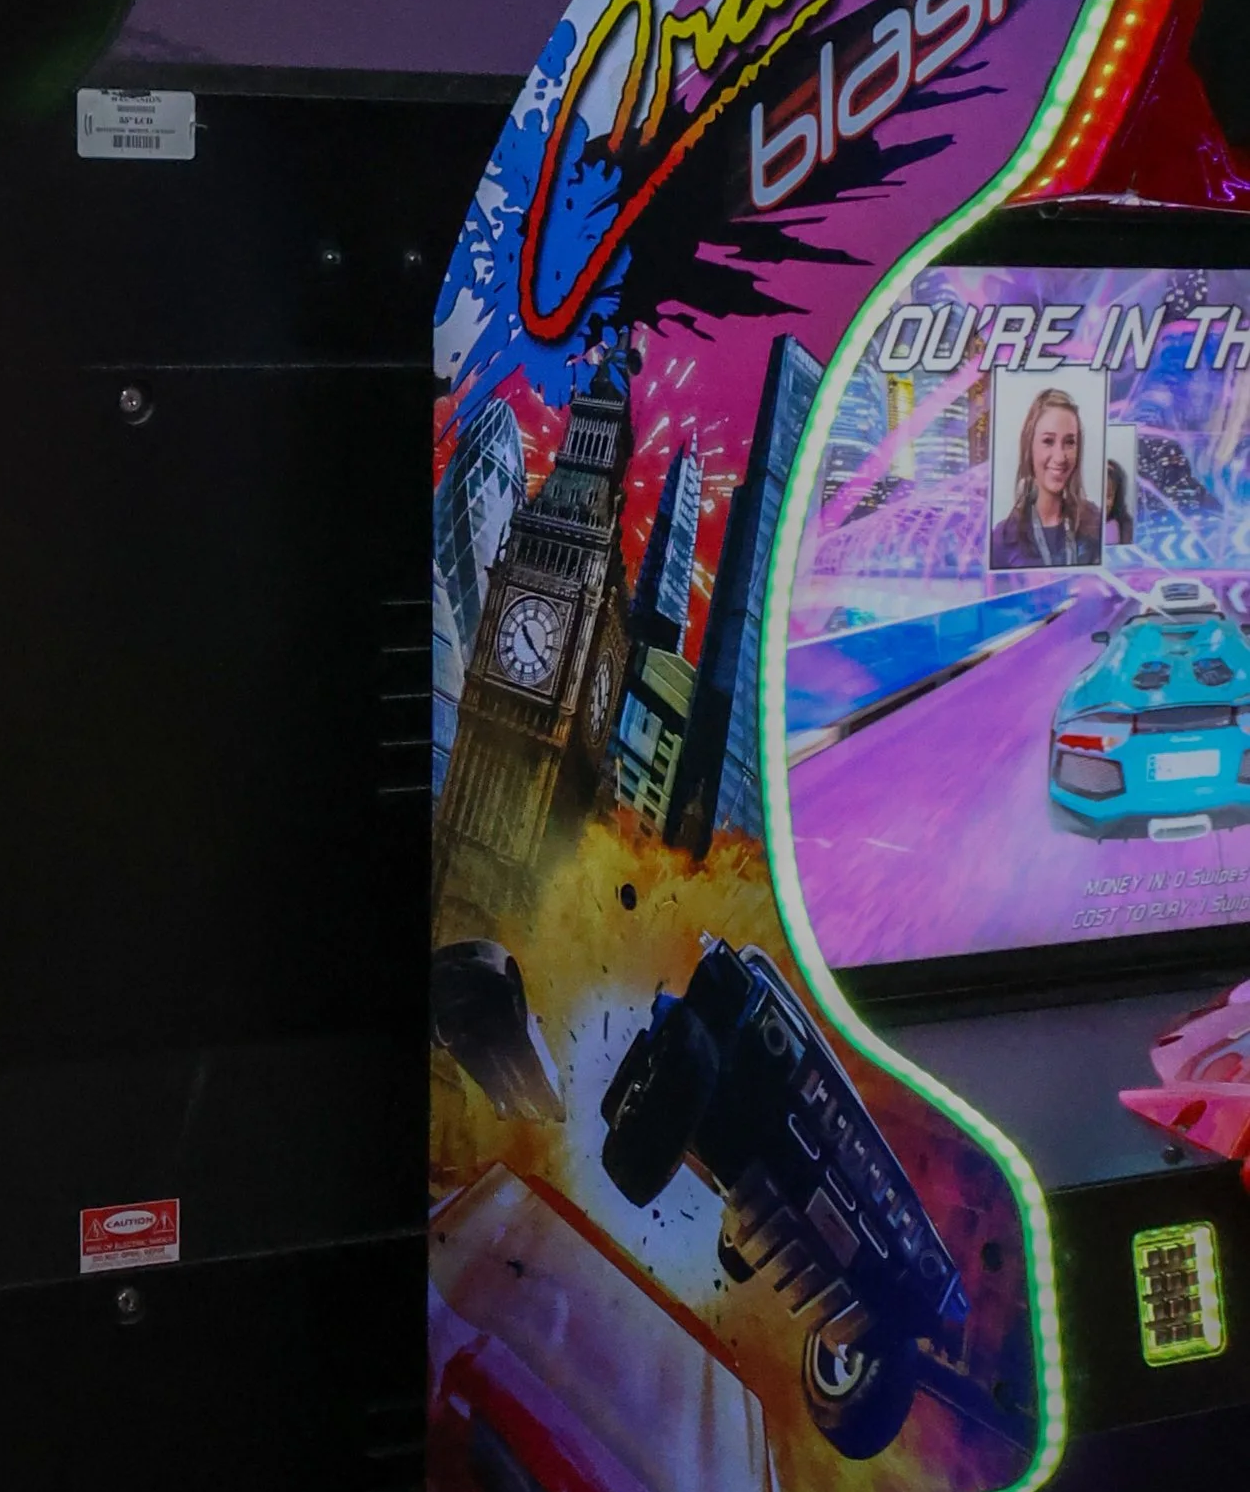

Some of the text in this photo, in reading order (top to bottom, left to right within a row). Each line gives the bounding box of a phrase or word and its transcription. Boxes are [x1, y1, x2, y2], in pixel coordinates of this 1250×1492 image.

[878, 305, 1083, 372] OU'RE
[1090, 305, 1153, 371] IN
[1085, 875, 1144, 897] MONEY
[1072, 906, 1119, 929] COST
[1127, 902, 1147, 922] TO
[106, 1215, 154, 1230] CAUTION
